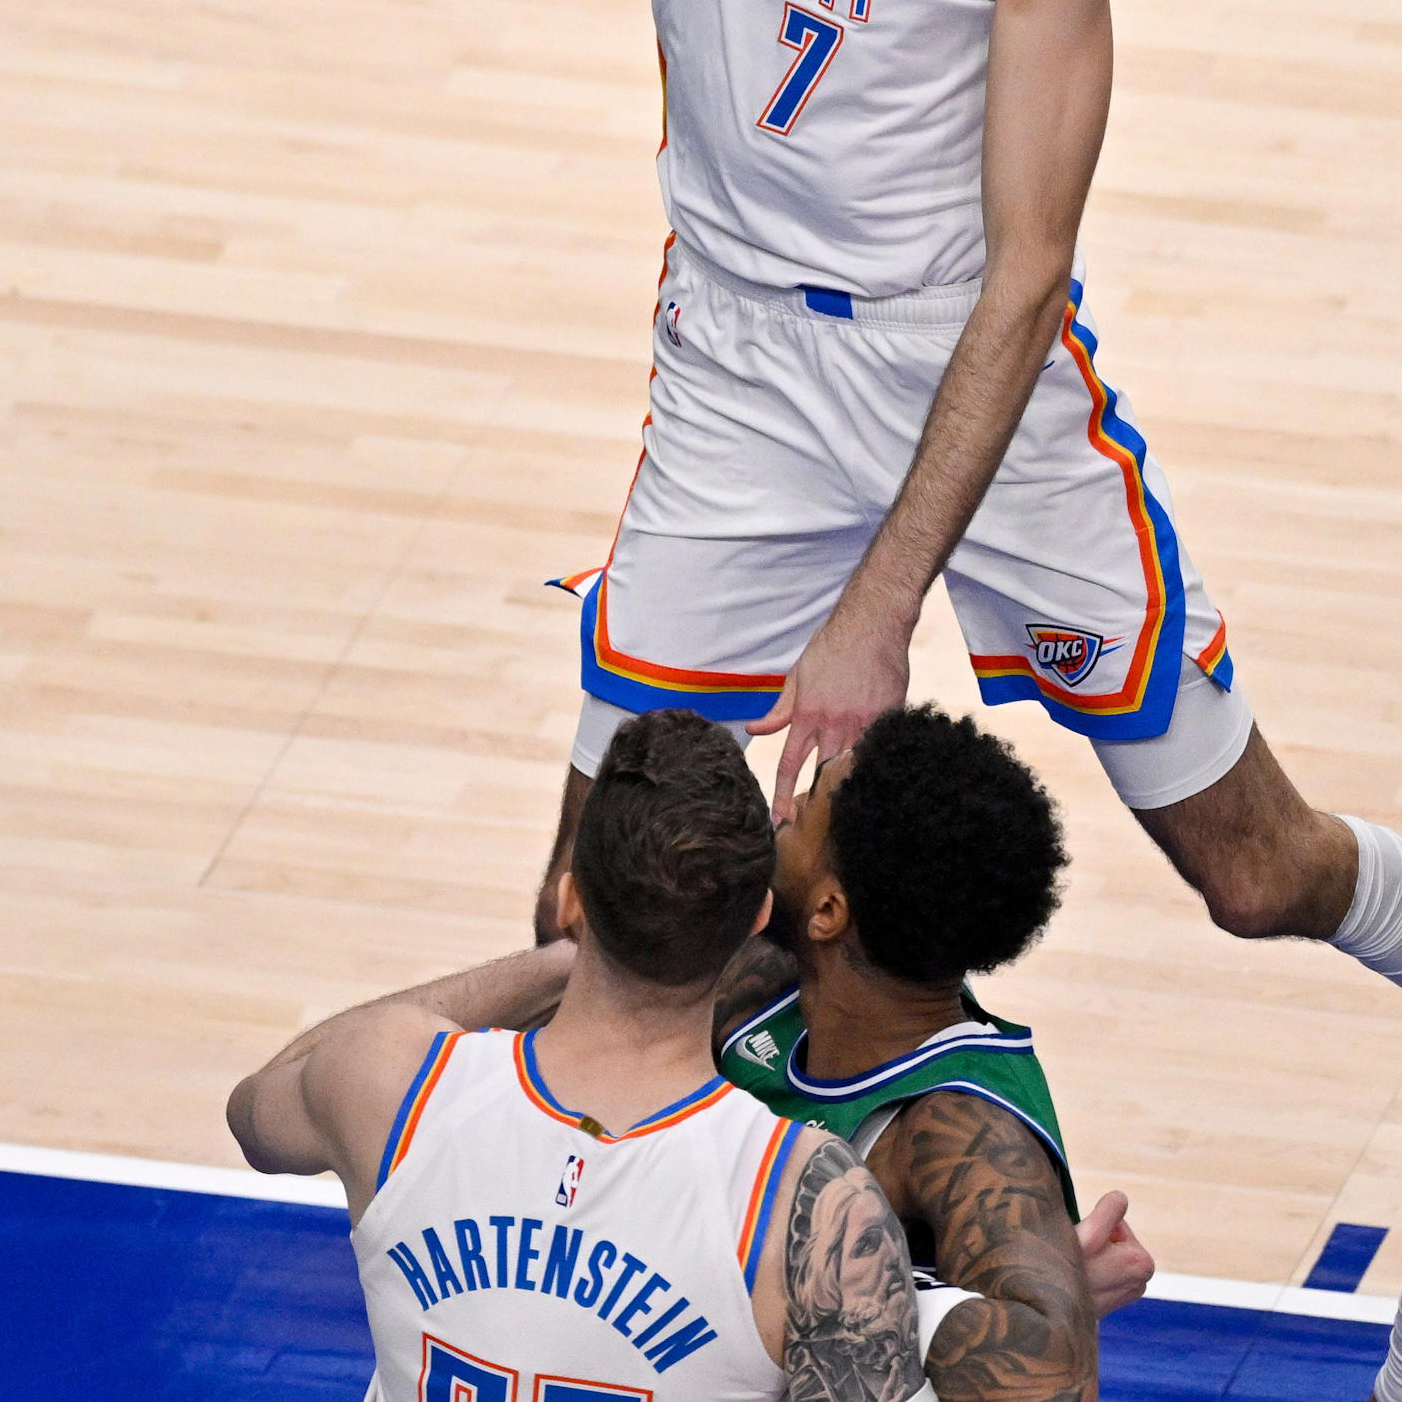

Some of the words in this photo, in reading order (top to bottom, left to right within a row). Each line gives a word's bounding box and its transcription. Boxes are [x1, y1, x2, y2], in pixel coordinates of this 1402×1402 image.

[756, 2, 844, 136] 7
[1038, 640, 1083, 664] OKC
[748, 1030, 780, 1059] NIKE
[386, 1215, 719, 1375] HARTENSTEIN
